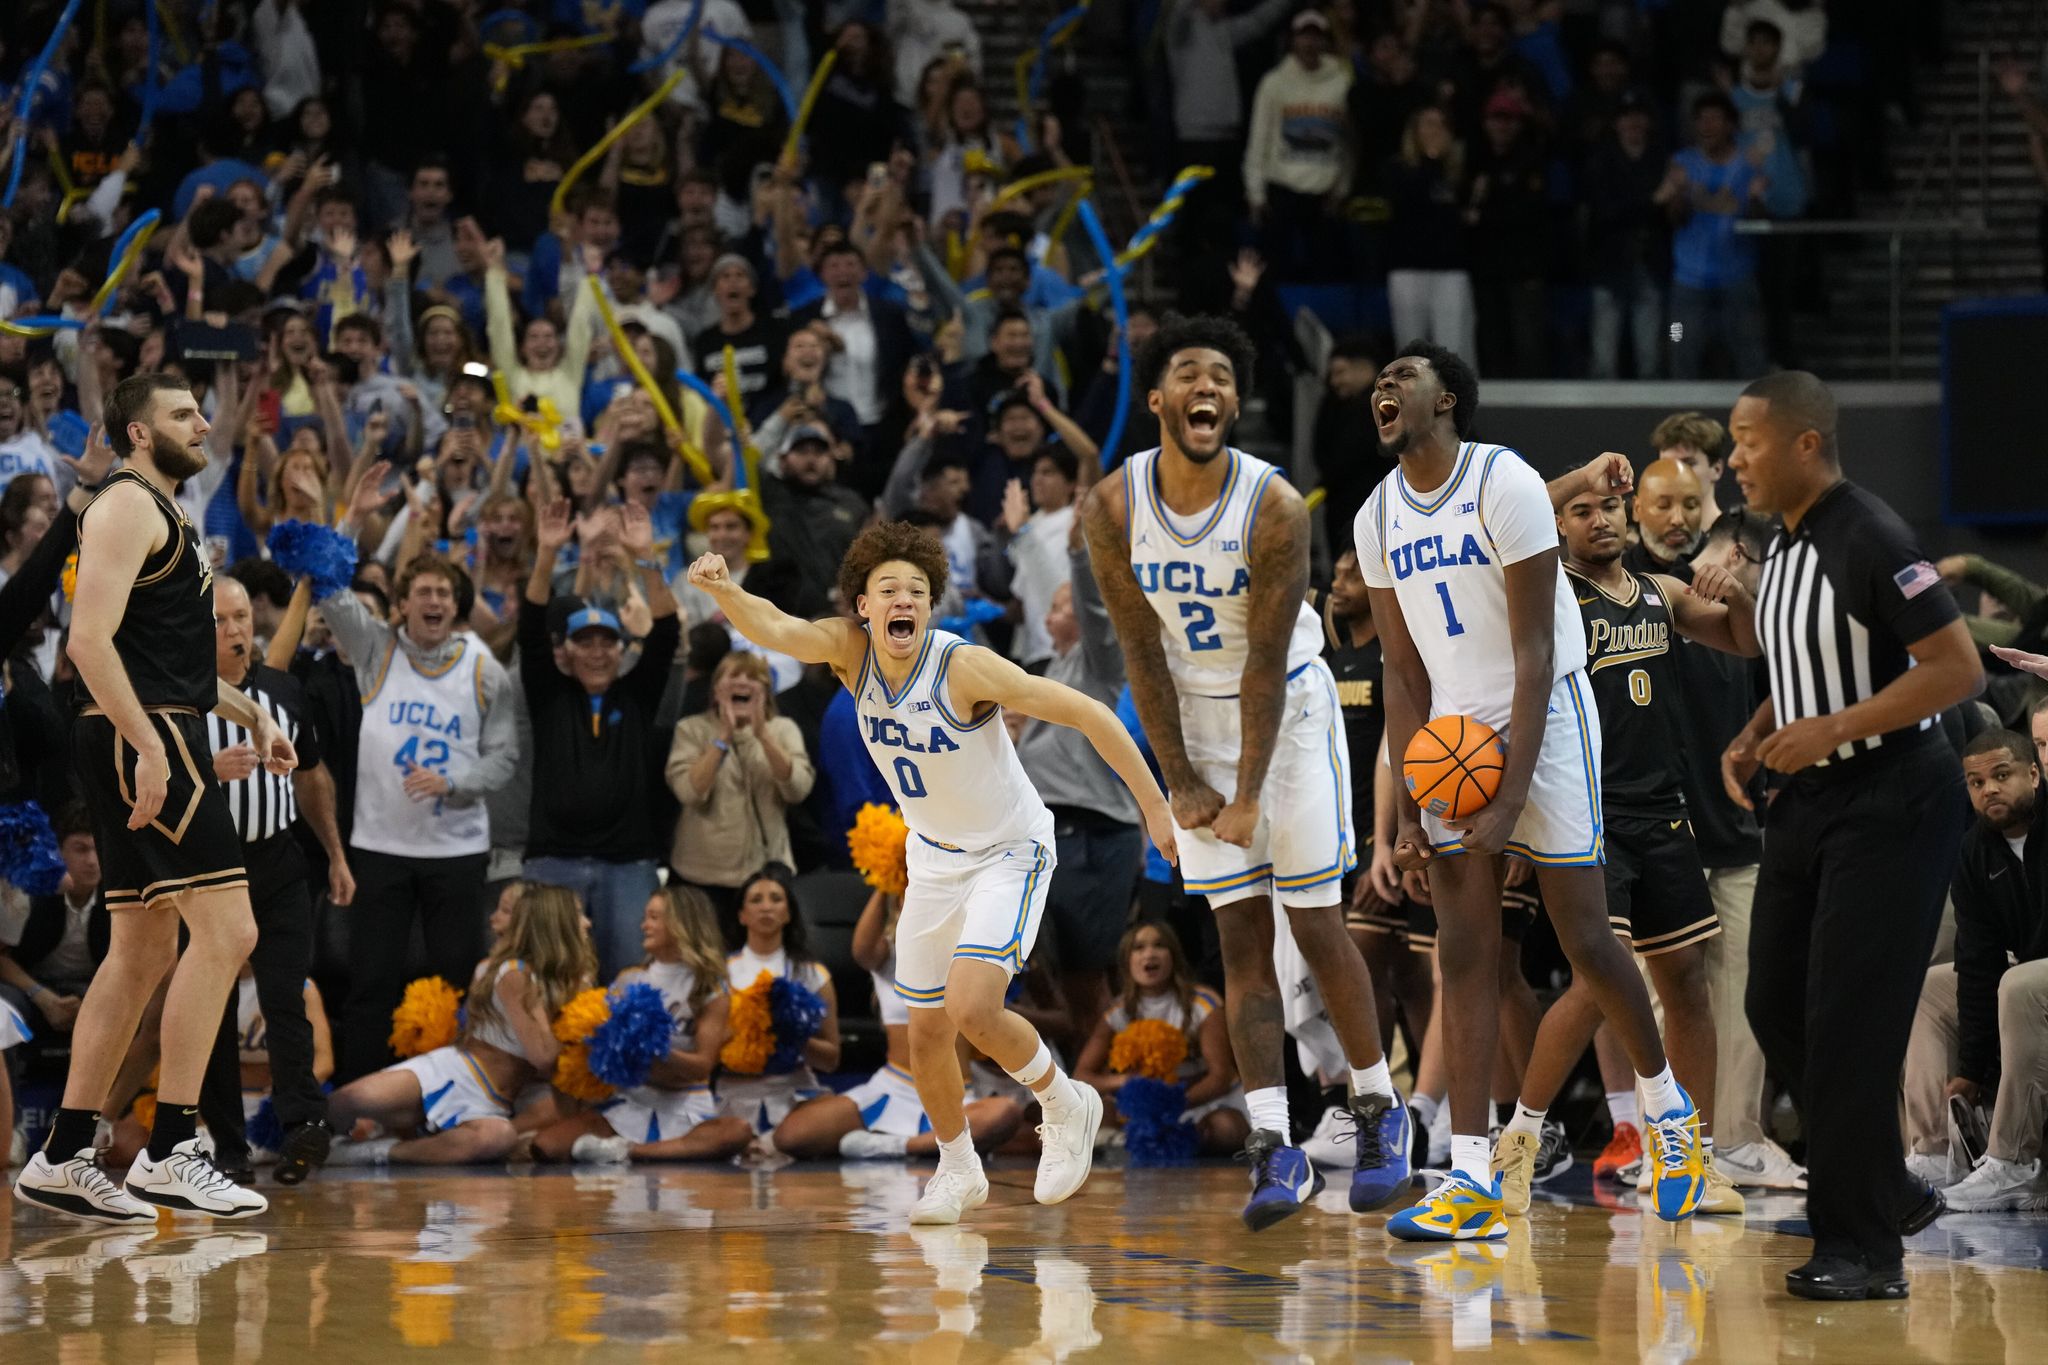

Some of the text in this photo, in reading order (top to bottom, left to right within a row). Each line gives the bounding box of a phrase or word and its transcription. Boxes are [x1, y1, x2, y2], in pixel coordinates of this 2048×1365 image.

[1390, 533, 1491, 581] UCLA
[1133, 561, 1251, 598] UCLA
[1178, 601, 1223, 652] 2
[1435, 581, 1465, 637] 1
[1587, 617, 1670, 657] Purdue
[1628, 669, 1652, 706] 0
[389, 702, 462, 740] UCLA
[863, 714, 961, 754] UCLA
[893, 756, 928, 798] 0
